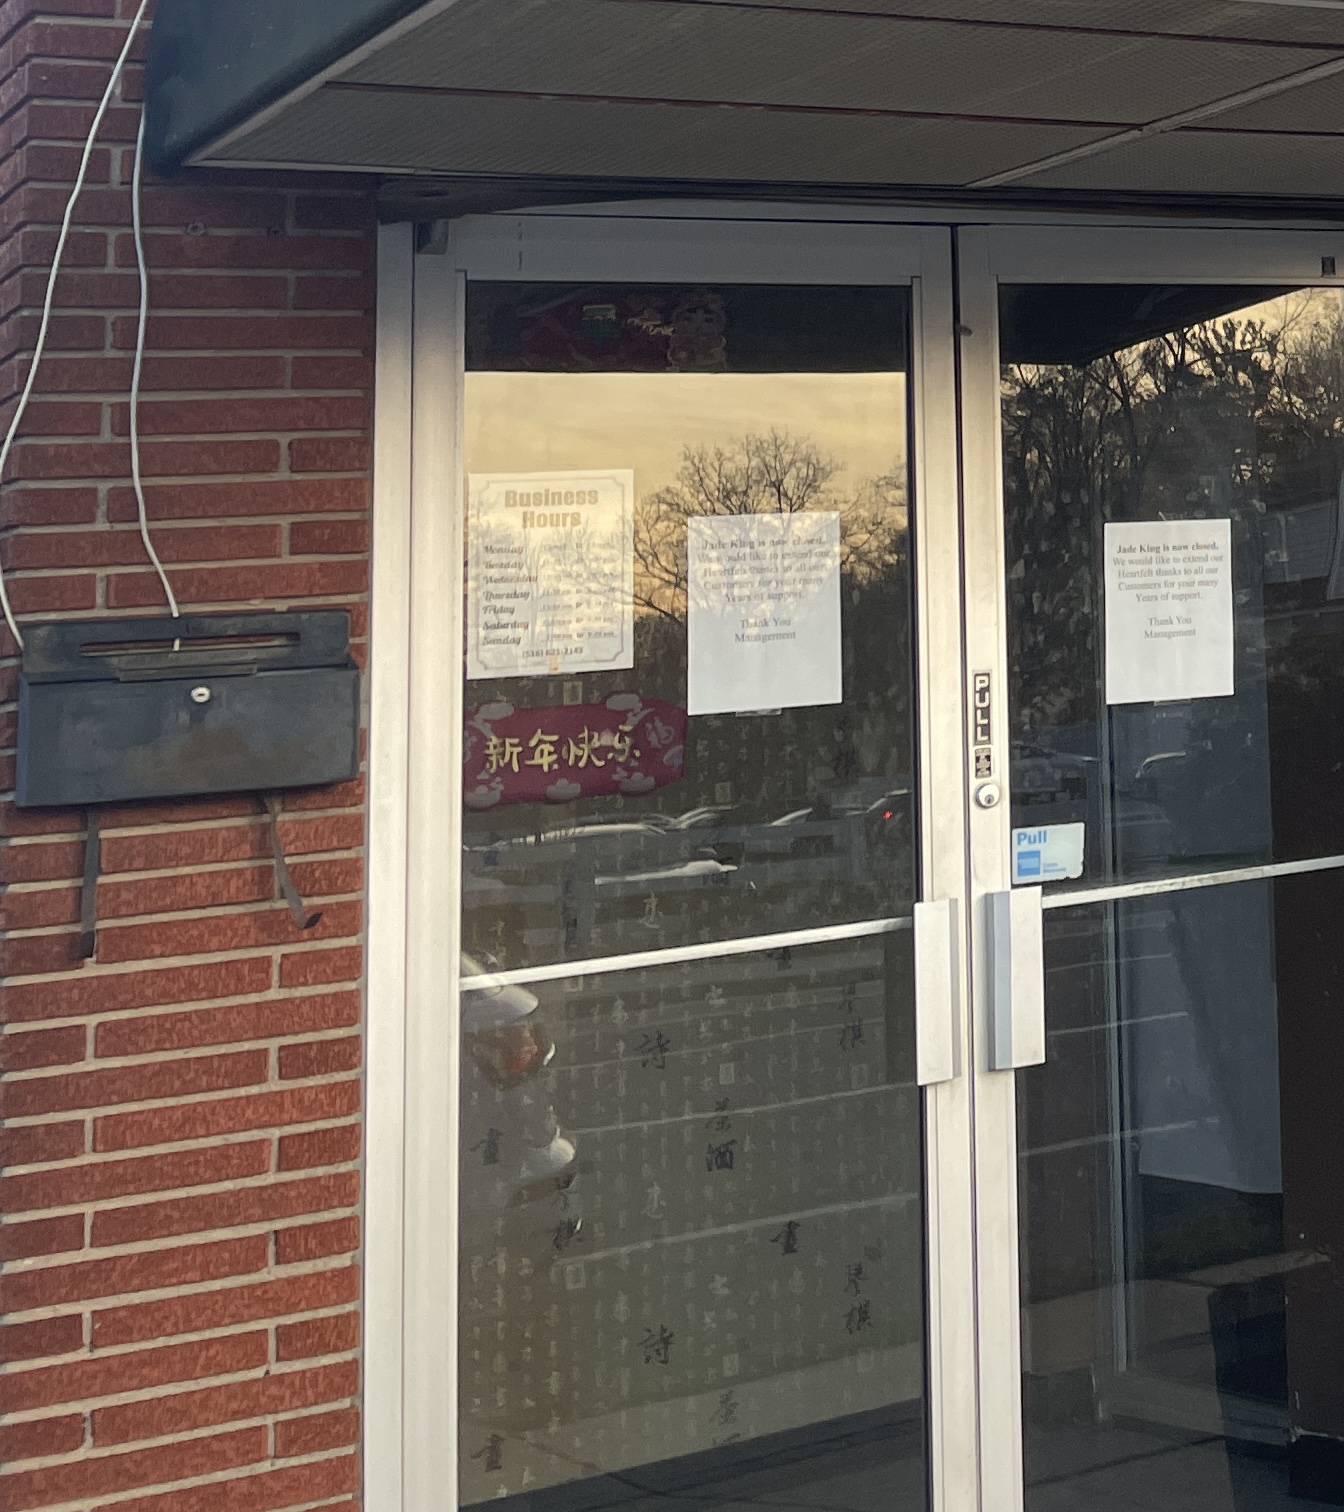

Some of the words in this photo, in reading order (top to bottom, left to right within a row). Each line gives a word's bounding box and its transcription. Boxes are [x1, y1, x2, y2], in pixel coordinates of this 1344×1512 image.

[504, 489, 598, 508] Business
[522, 511, 581, 529] Hours
[702, 539, 726, 550] Jade
[730, 538, 754, 549] King
[1117, 545, 1136, 554] Jade
[1139, 544, 1160, 554] King
[1163, 543, 1169, 552] is
[1192, 542, 1218, 551] closed.
[1113, 557, 1125, 566] We
[1128, 556, 1152, 565] would
[1155, 556, 1170, 564] like
[1182, 554, 1208, 563] extend
[1118, 568, 1153, 578] Heartfelt
[1155, 568, 1182, 576] thanks
[1194, 566, 1203, 575] all
[483, 575, 538, 584] Wednesday
[1118, 582, 1161, 591] Customers
[1164, 580, 1176, 588] for
[1178, 580, 1195, 590] your
[1198, 579, 1218, 588] many
[483, 590, 530, 601] Thursday
[726, 593, 751, 603] Years
[754, 592, 764, 601] of
[1136, 593, 1158, 602] Years
[1160, 592, 1170, 600] of
[1171, 592, 1202, 602] support.
[482, 605, 515, 615] Friday
[482, 621, 529, 631] Saturday
[740, 618, 769, 629] Thank
[773, 617, 791, 627] You
[1148, 616, 1173, 626] Thank
[1176, 615, 1192, 625] You
[735, 631, 796, 643] Management
[1144, 628, 1196, 639] Management
[482, 636, 521, 646] Sunday
[975, 675, 990, 741] PULL
[484, 724, 640, 773] 新年快乐
[1017, 830, 1047, 846] Pull
